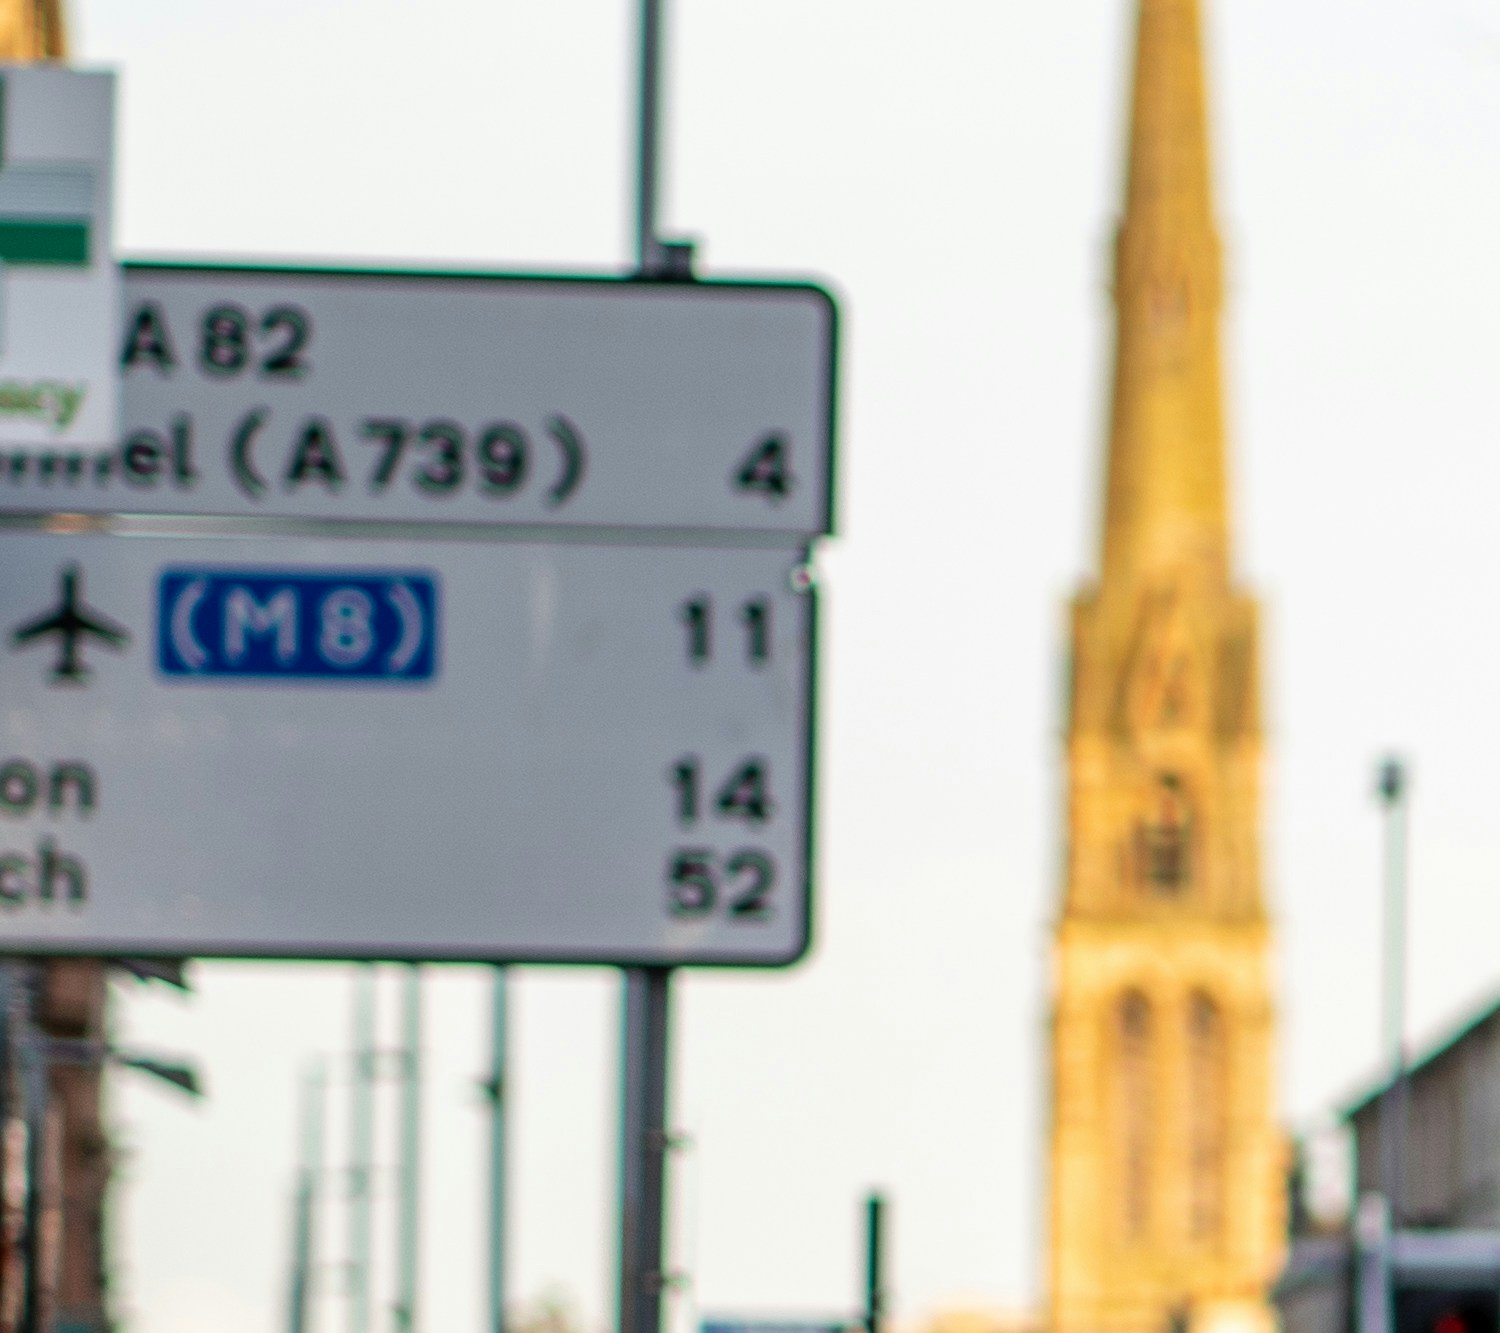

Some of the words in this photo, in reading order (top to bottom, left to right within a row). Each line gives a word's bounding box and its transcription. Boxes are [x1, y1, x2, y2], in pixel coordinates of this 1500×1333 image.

[734, 432, 796, 500] 4
[682, 592, 770, 664] 11
[668, 757, 774, 828] 14
[667, 850, 777, 920] 52
